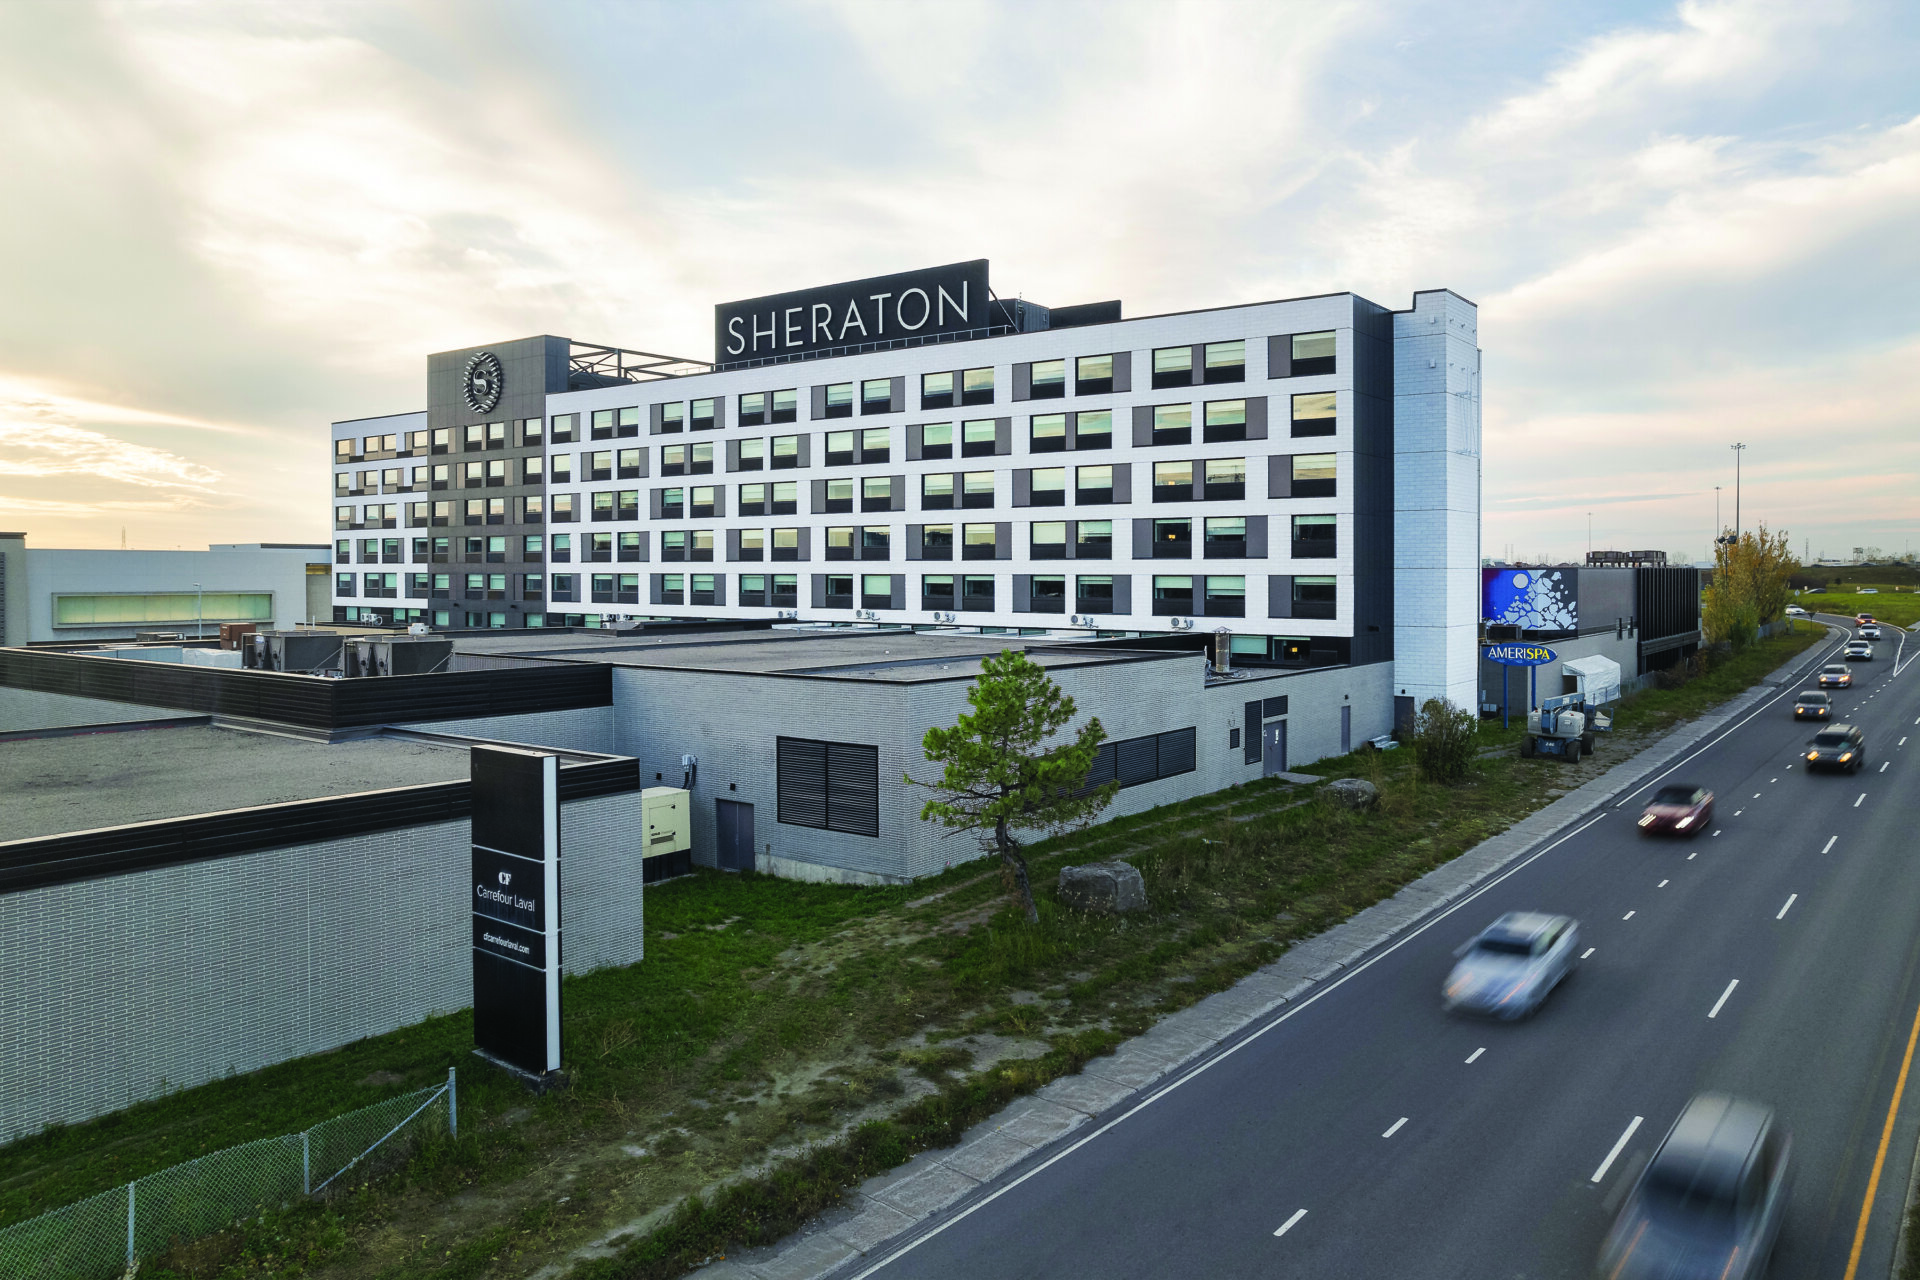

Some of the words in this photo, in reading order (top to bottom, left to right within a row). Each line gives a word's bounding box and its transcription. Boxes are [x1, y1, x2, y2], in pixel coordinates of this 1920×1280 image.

[726, 280, 968, 355] SHERATON
[473, 369, 487, 395] S
[1488, 646, 1550, 660] AMERISPA
[498, 871, 512, 886] CF
[476, 884, 513, 906] Carrefour
[514, 894, 536, 913] Laval
[483, 932, 530, 955] cfcarrefourlaval.com
